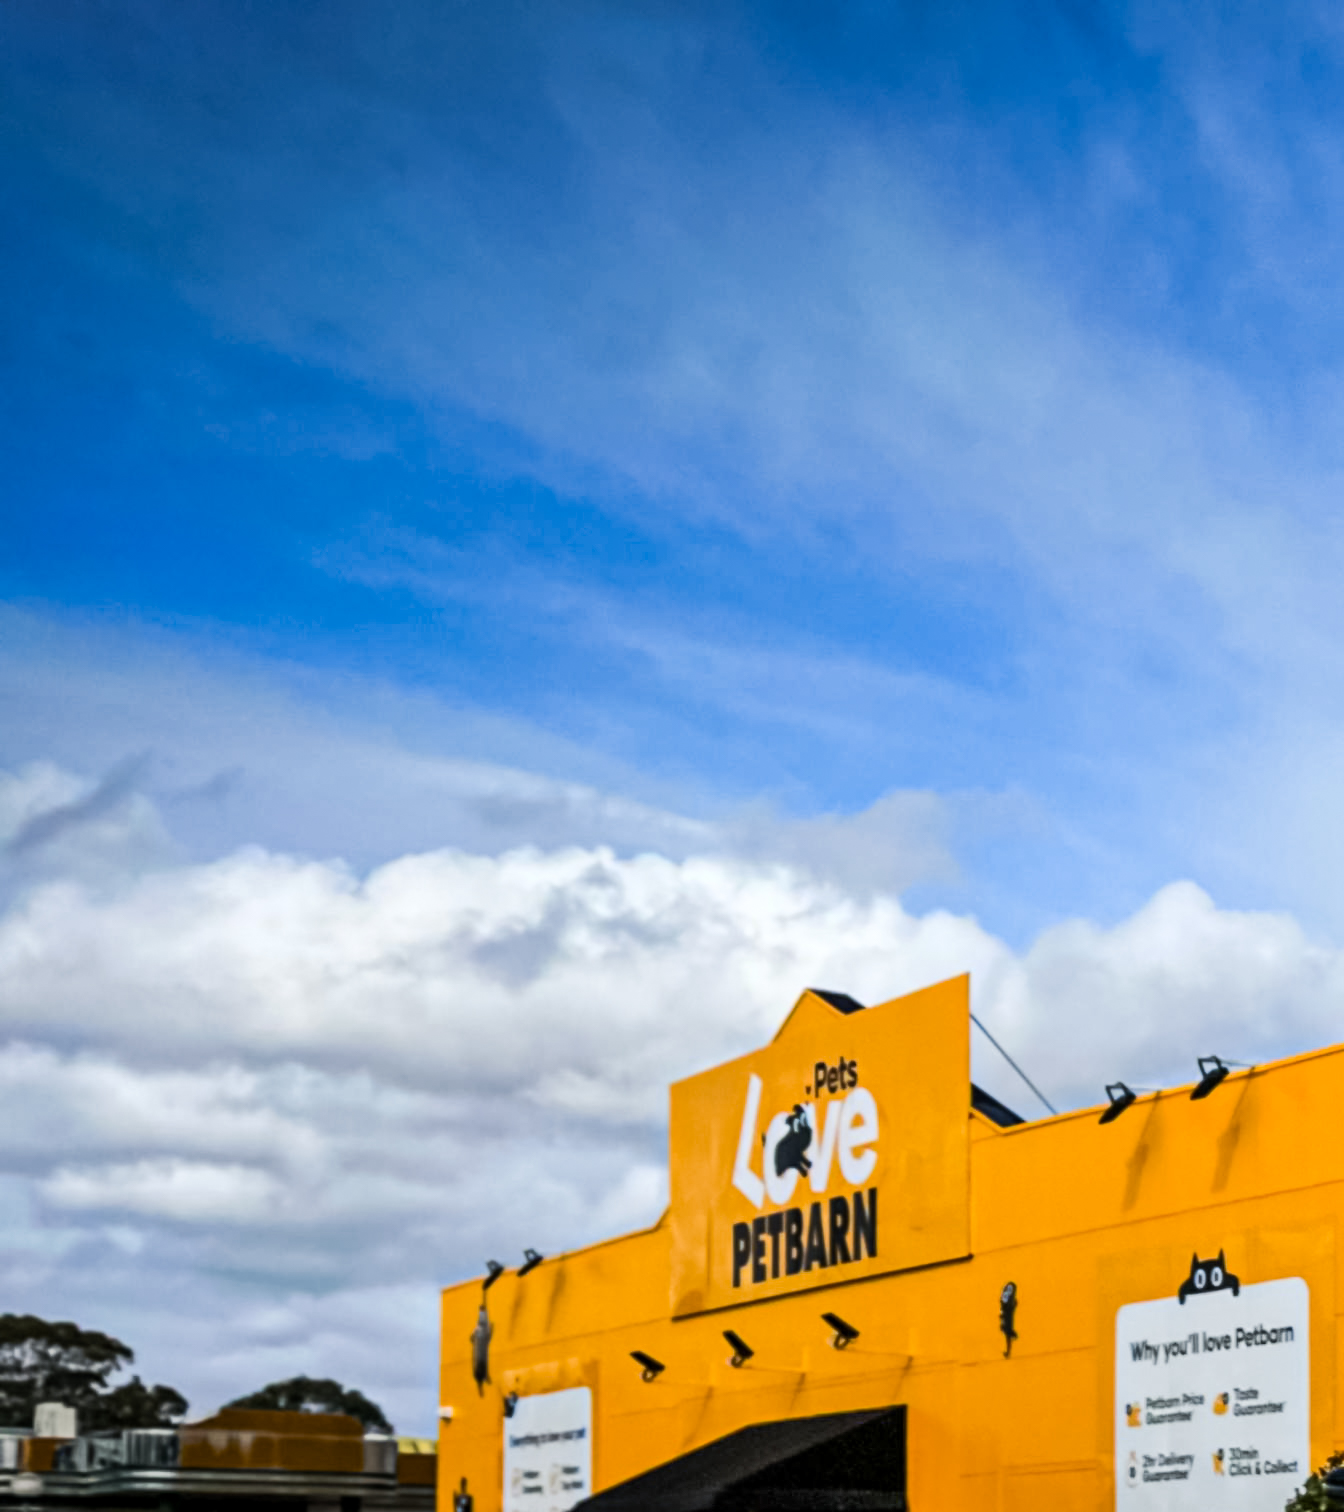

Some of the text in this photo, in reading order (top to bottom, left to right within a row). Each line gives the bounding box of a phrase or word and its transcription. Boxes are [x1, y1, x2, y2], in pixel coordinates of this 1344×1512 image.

[814, 1056, 858, 1098] Pets
[732, 1071, 880, 1210] Love
[732, 1187, 878, 1288] PETBARN
[1129, 1324, 1295, 1366] Why you'll love Petbarn
[1264, 1459, 1298, 1475] Collect
